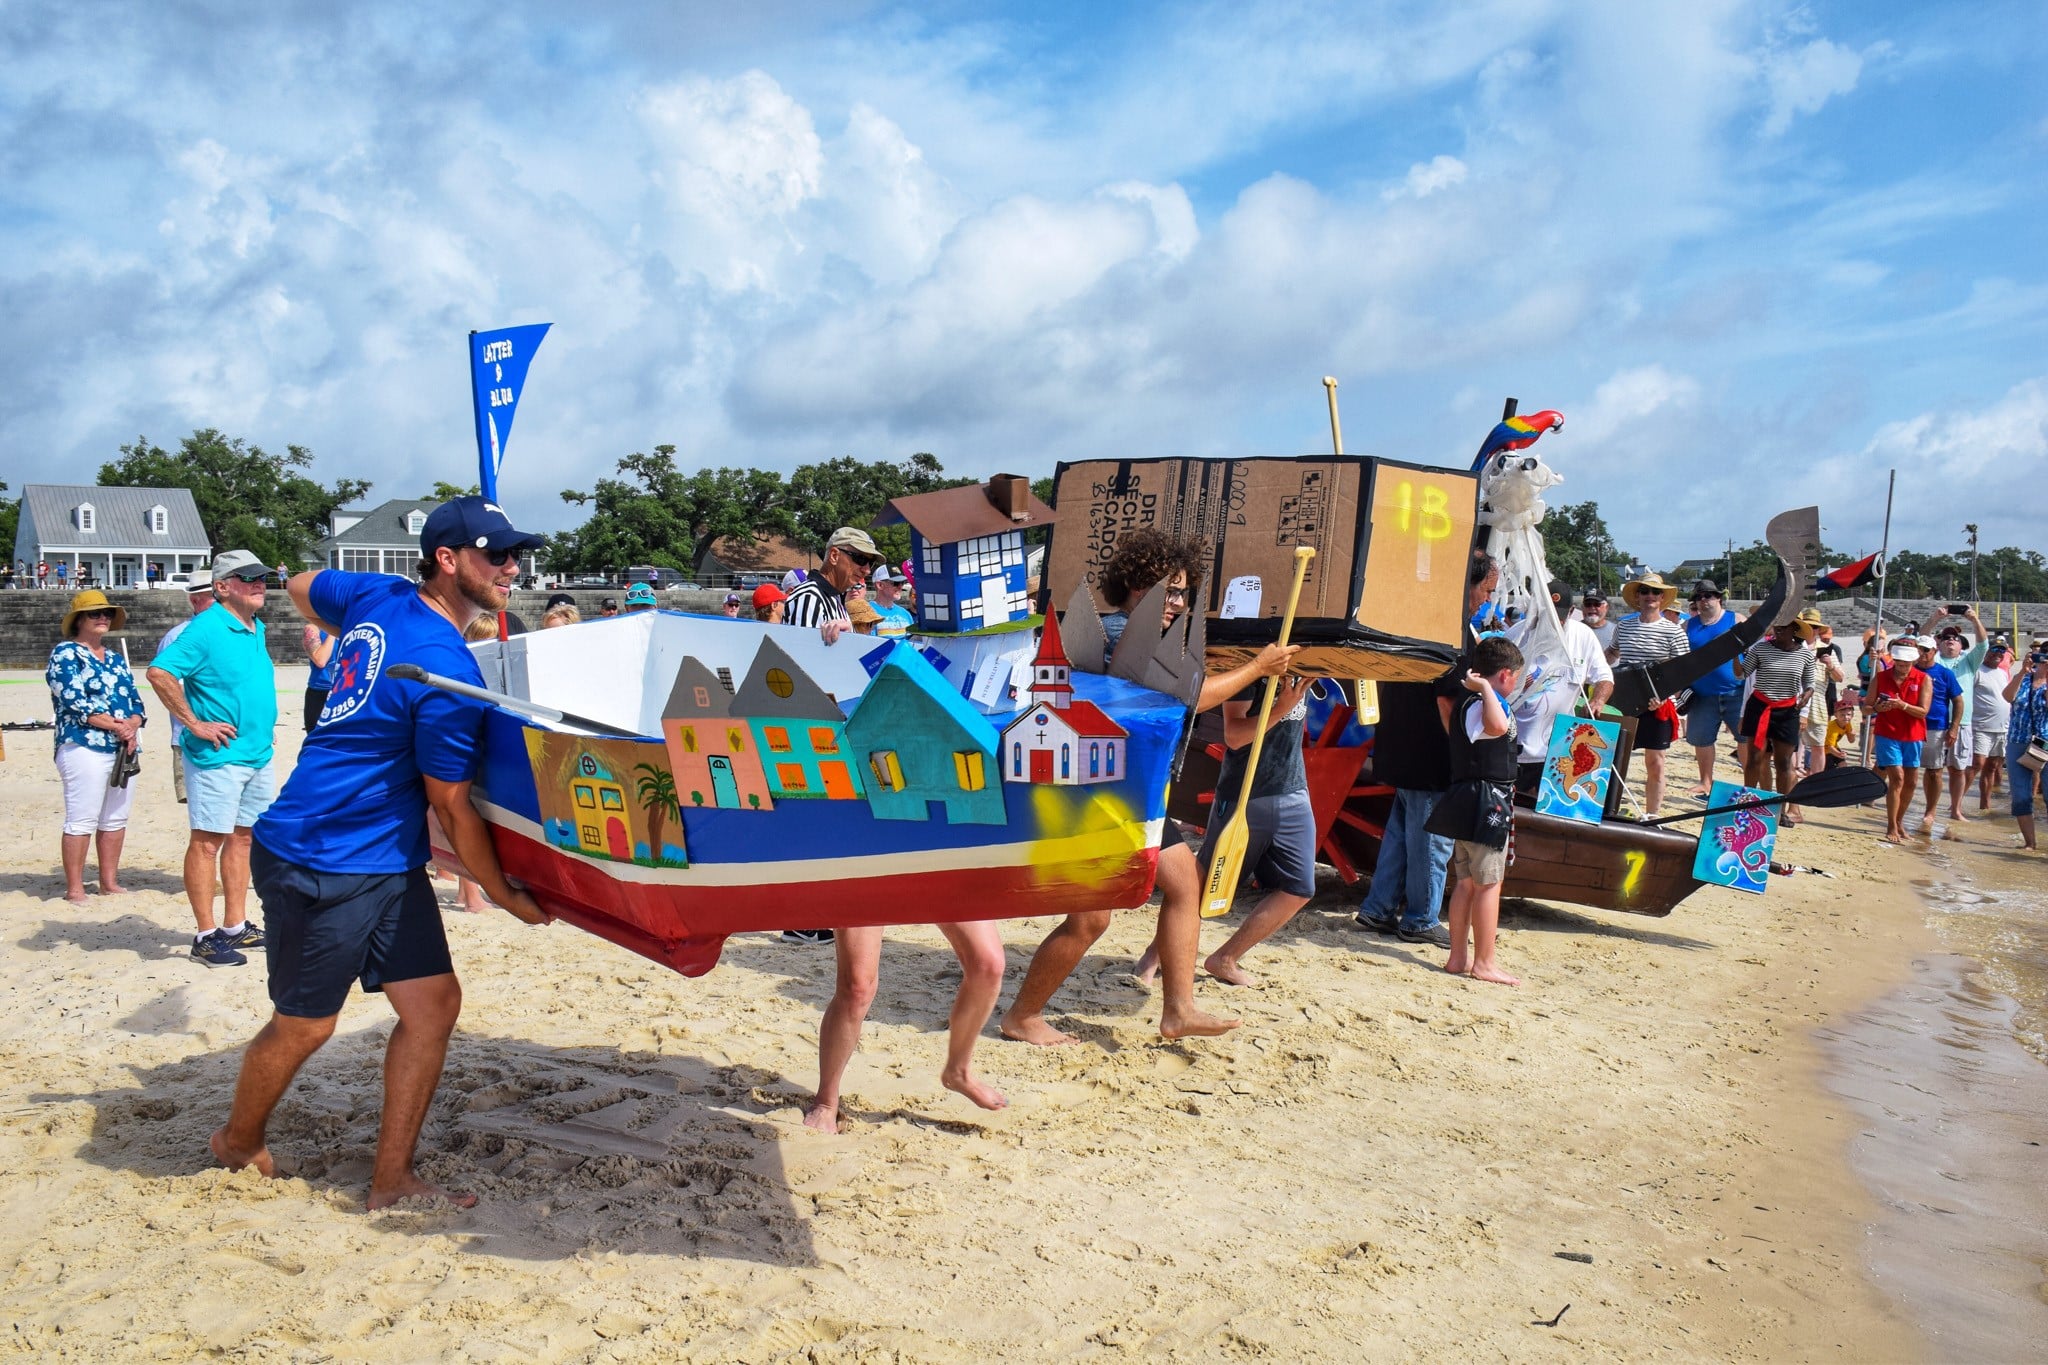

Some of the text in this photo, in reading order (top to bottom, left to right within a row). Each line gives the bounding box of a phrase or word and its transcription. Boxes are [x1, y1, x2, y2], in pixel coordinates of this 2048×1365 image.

[483, 339, 513, 364] LATTER
[1216, 505, 1229, 543] WARNING
[330, 696, 356, 718] 1916
[1622, 851, 1646, 898] 7
